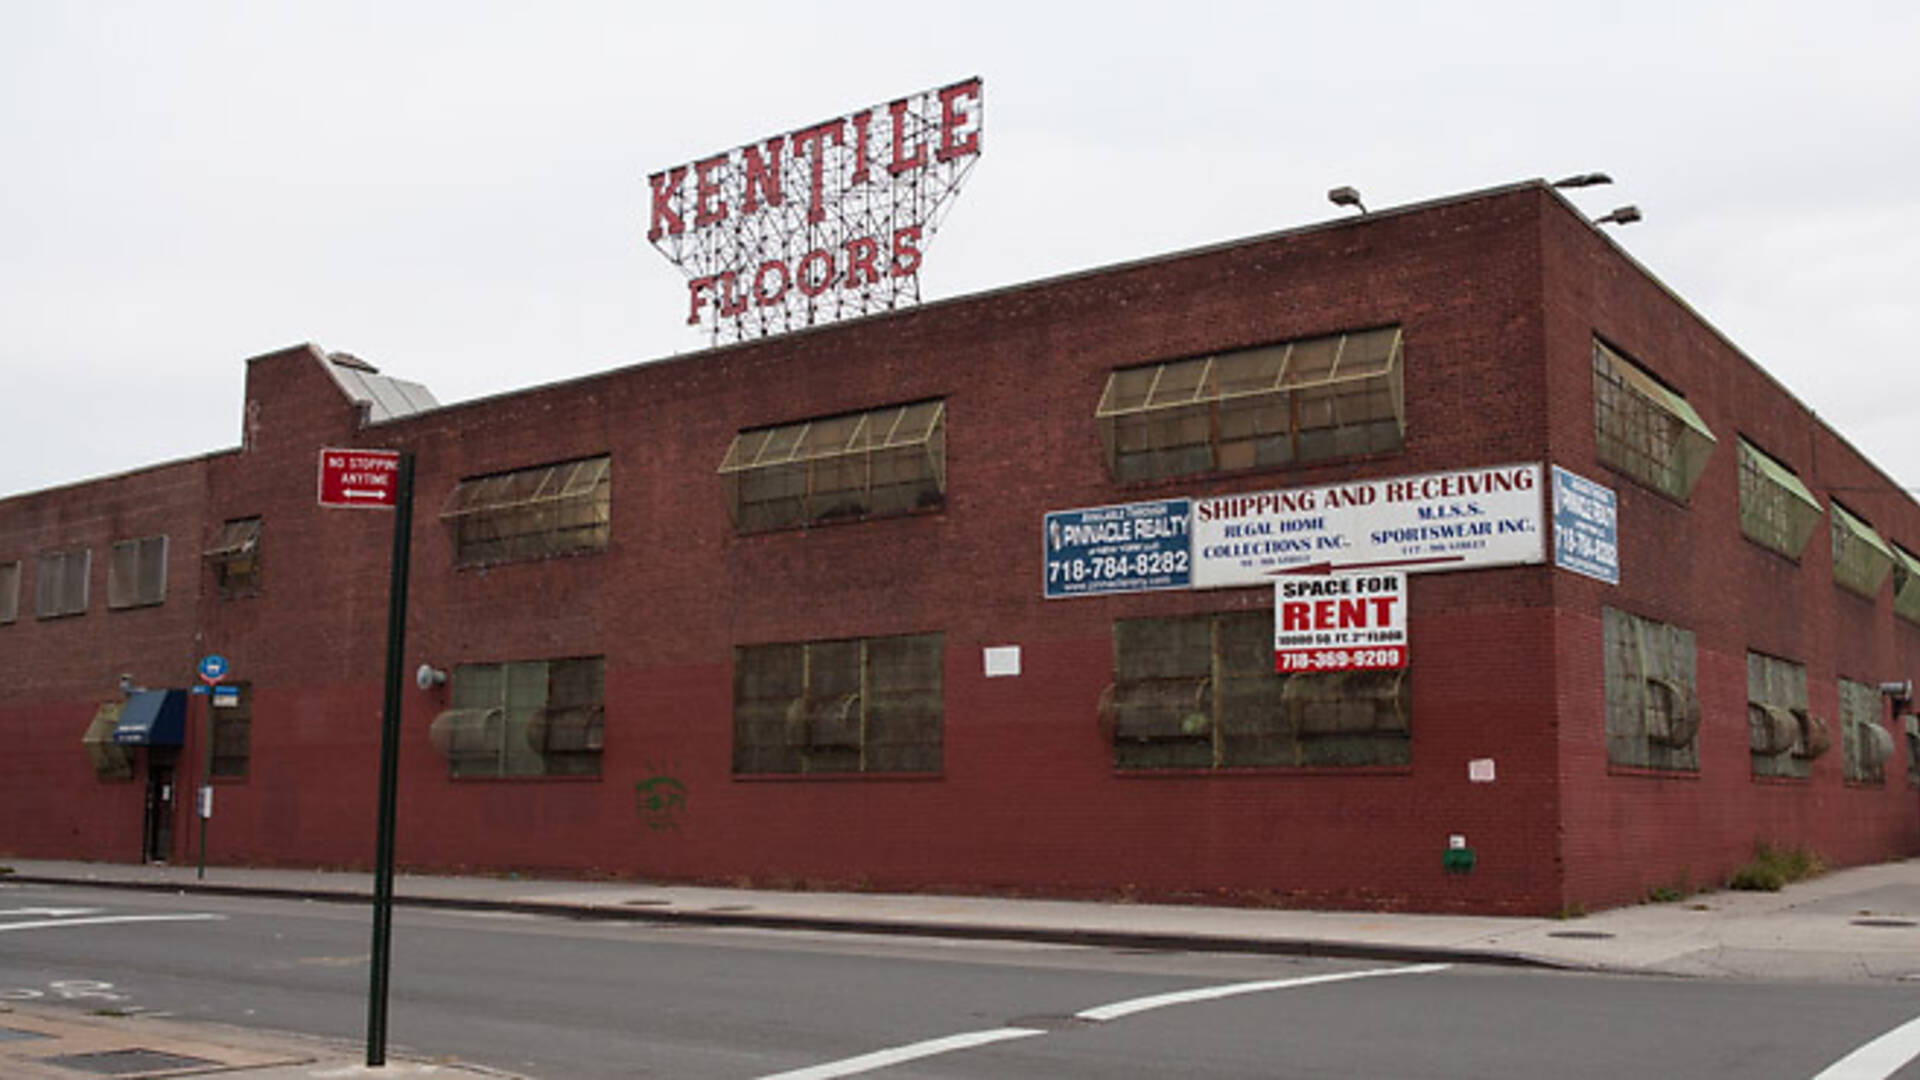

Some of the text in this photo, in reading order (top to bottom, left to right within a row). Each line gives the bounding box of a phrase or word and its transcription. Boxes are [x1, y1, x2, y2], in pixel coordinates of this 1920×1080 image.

[648, 78, 980, 242] KENTILE
[687, 224, 922, 325] FLOORS
[329, 457, 398, 470] NO STOPPIN
[1198, 490, 1315, 521] SHIPPING
[1324, 485, 1376, 509] AND
[1386, 469, 1534, 503] RECEIVING
[1064, 513, 1190, 546] PINNACLE REALTY
[1225, 517, 1325, 538] REGAL HOME
[1371, 518, 1536, 545] SPORTSWEAR INC.
[1204, 534, 1351, 559] COLLECTIONS INC.
[1049, 550, 1188, 583] 718-784-8282
[1283, 576, 1398, 598] SPACE FOR
[1283, 596, 1398, 632] RENT
